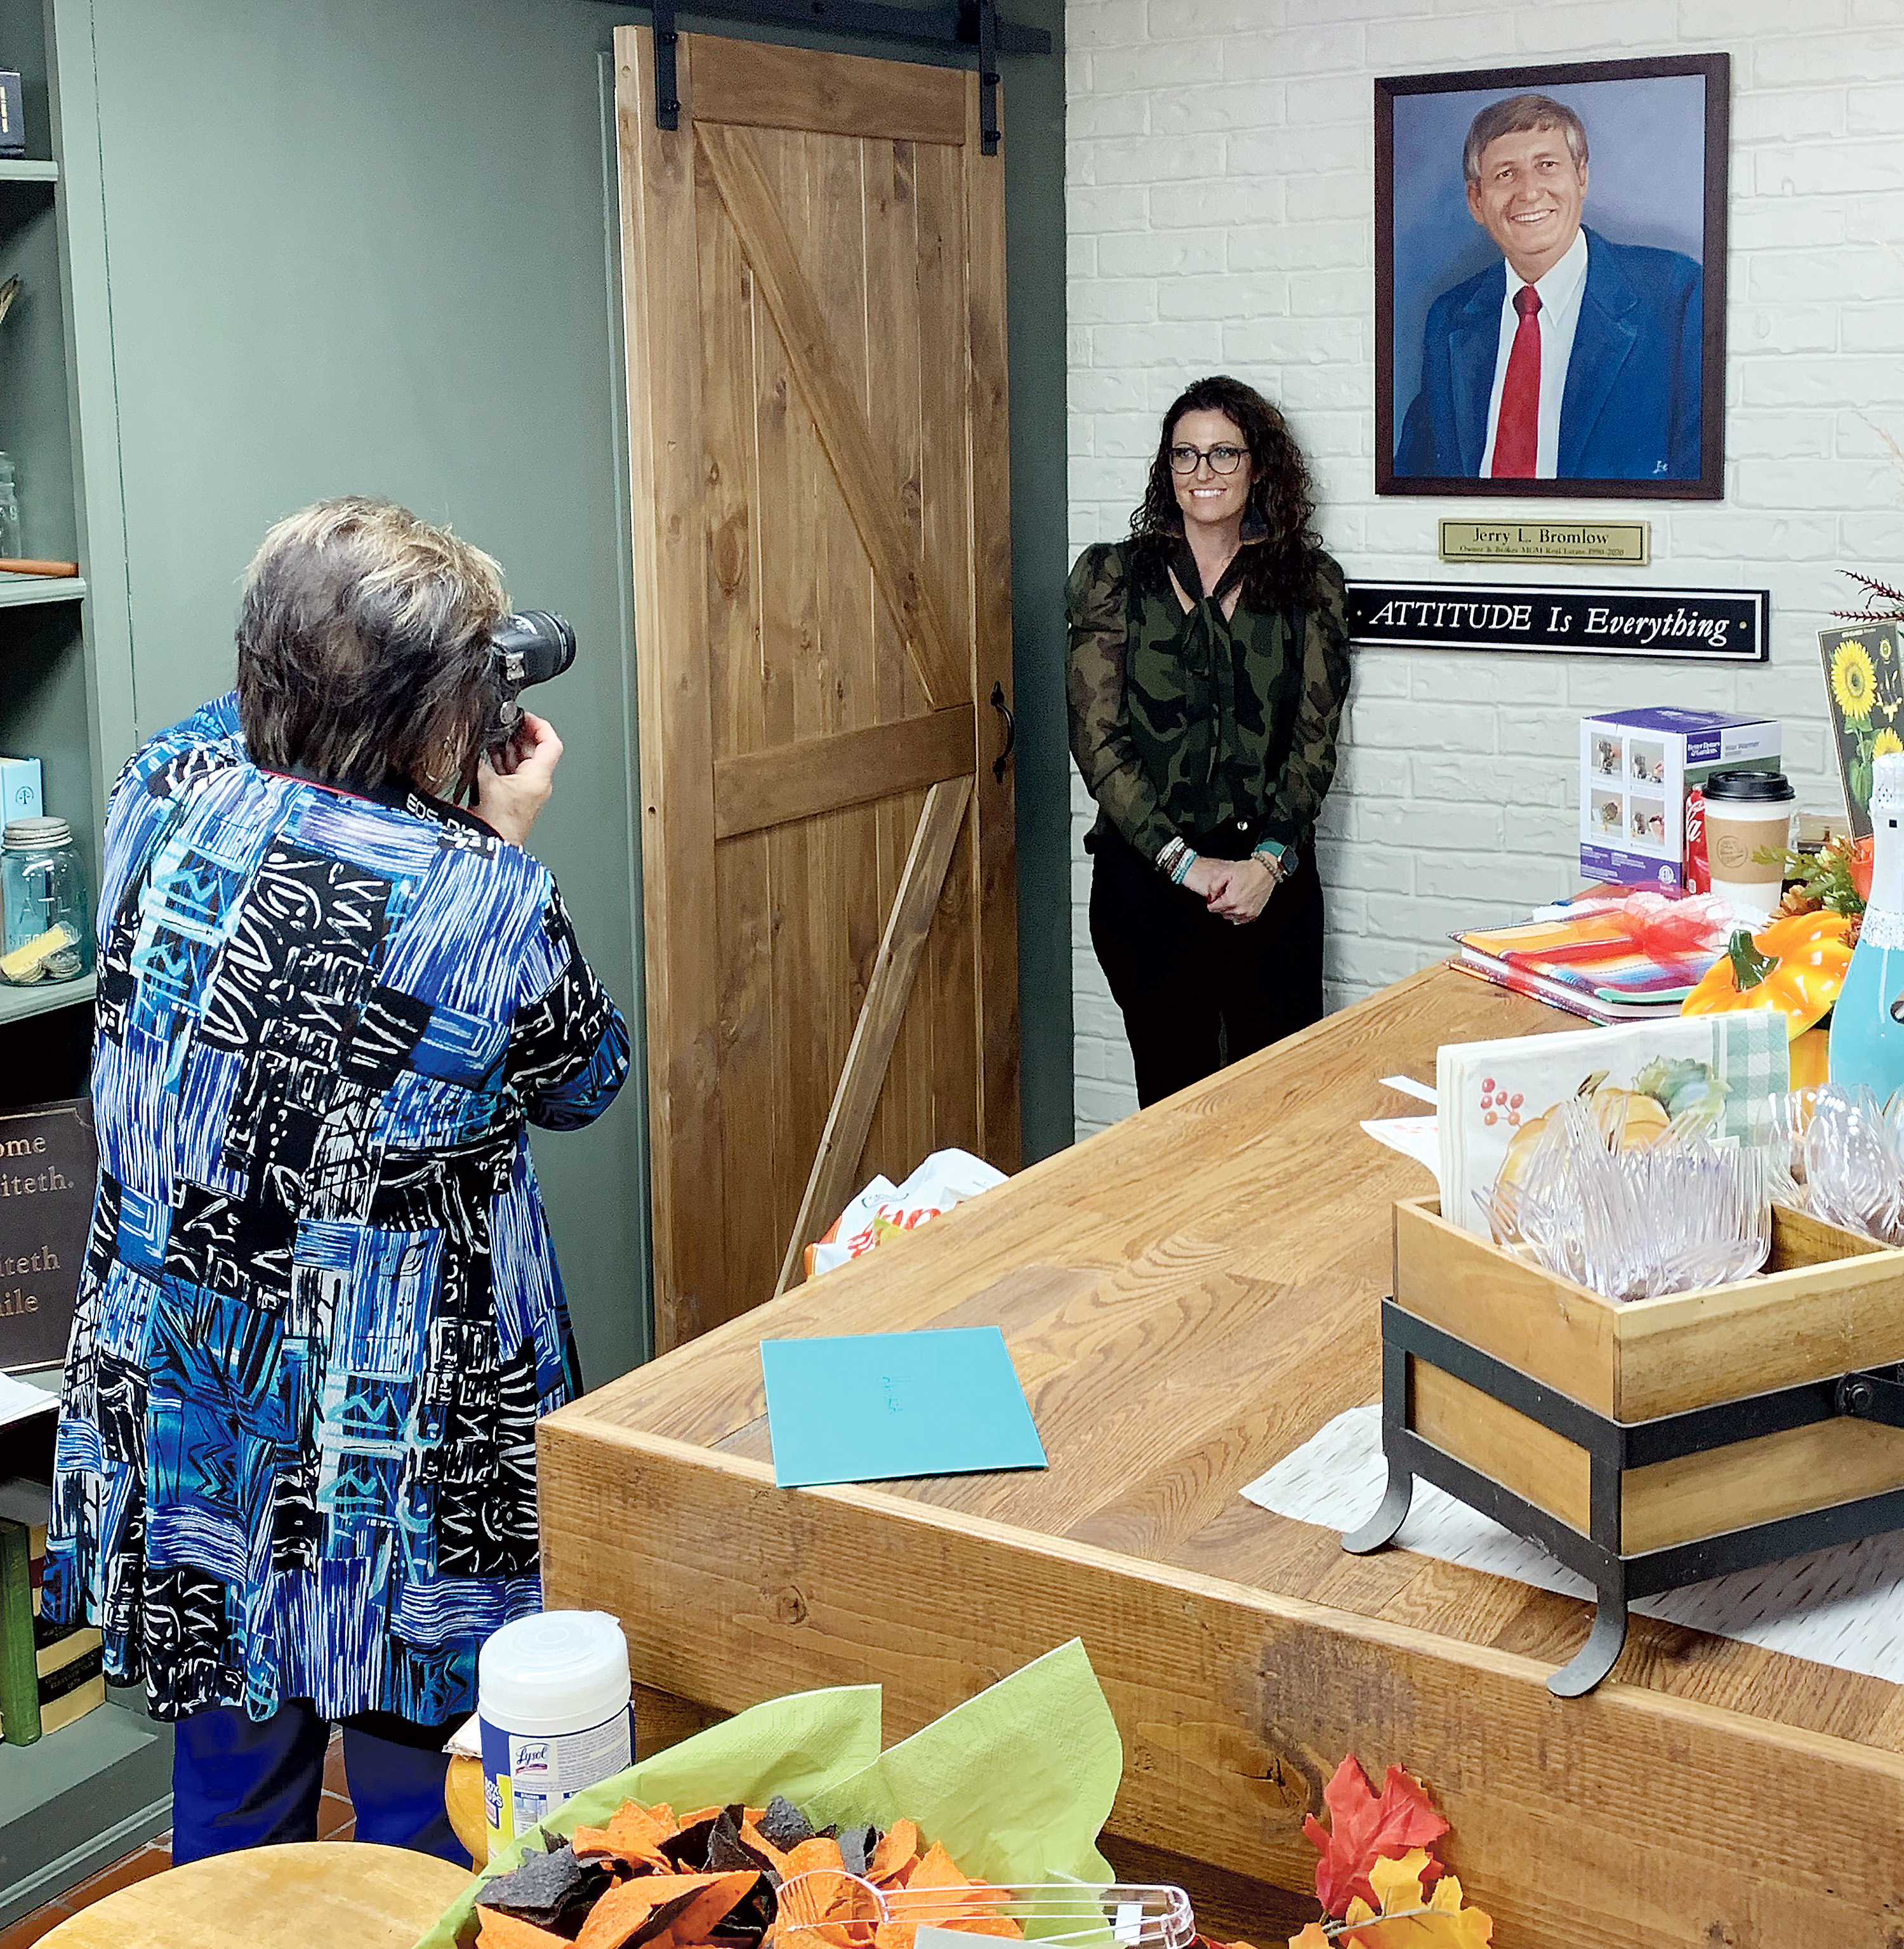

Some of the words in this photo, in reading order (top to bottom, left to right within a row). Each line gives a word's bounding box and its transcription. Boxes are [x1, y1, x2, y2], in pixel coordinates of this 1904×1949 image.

[1473, 527, 1510, 545] Jerry
[1518, 528, 1531, 542] L.
[1540, 528, 1610, 544] Bromlow
[1369, 601, 1532, 630] ATTITUDE
[1547, 607, 1572, 632] Is
[1584, 607, 1729, 647] Everything
[406, 793, 439, 823] EOS
[0, 1245, 61, 1278] teth
[0, 1288, 39, 1316] ile
[515, 1746, 548, 1765] Lysol
